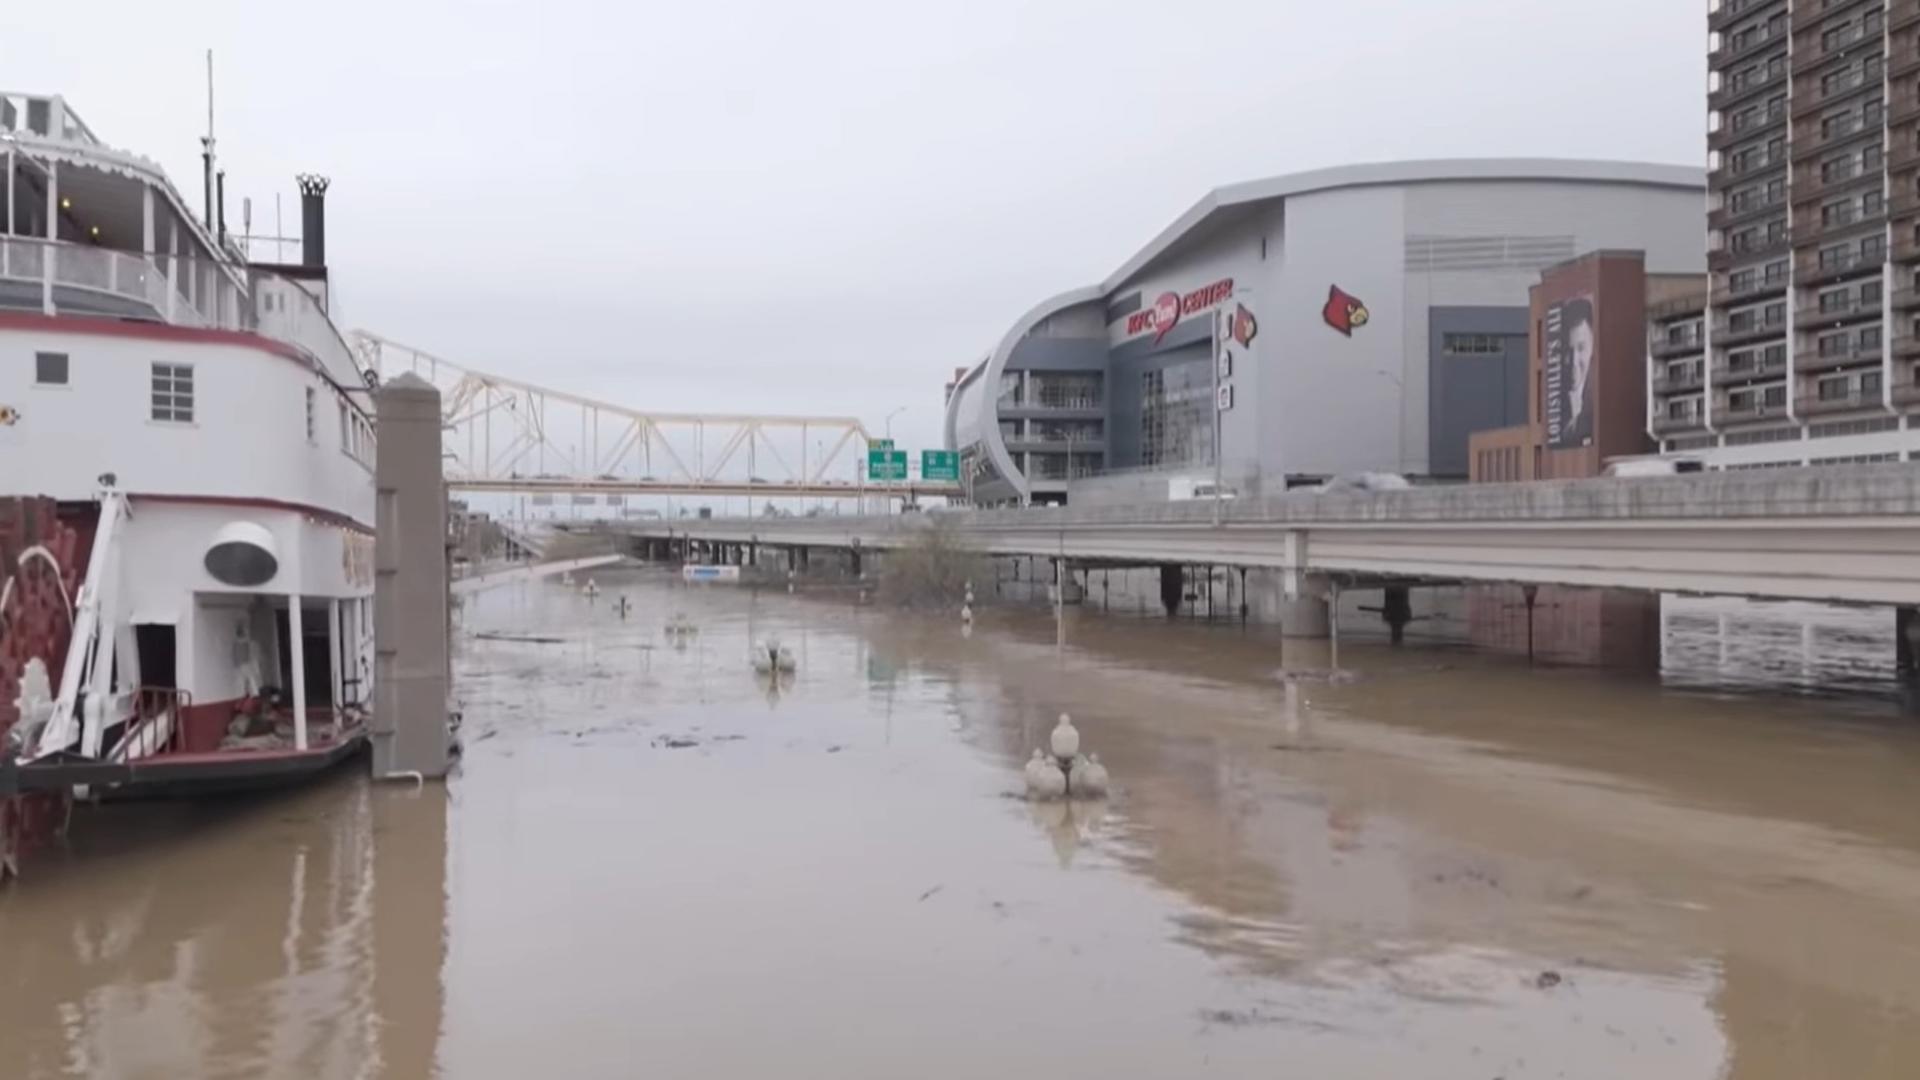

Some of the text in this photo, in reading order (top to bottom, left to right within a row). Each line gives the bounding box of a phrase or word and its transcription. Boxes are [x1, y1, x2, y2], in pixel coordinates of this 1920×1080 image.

[1183, 278, 1233, 315] CENTER
[1547, 307, 1562, 444] LOUISVILLE'S ALI
